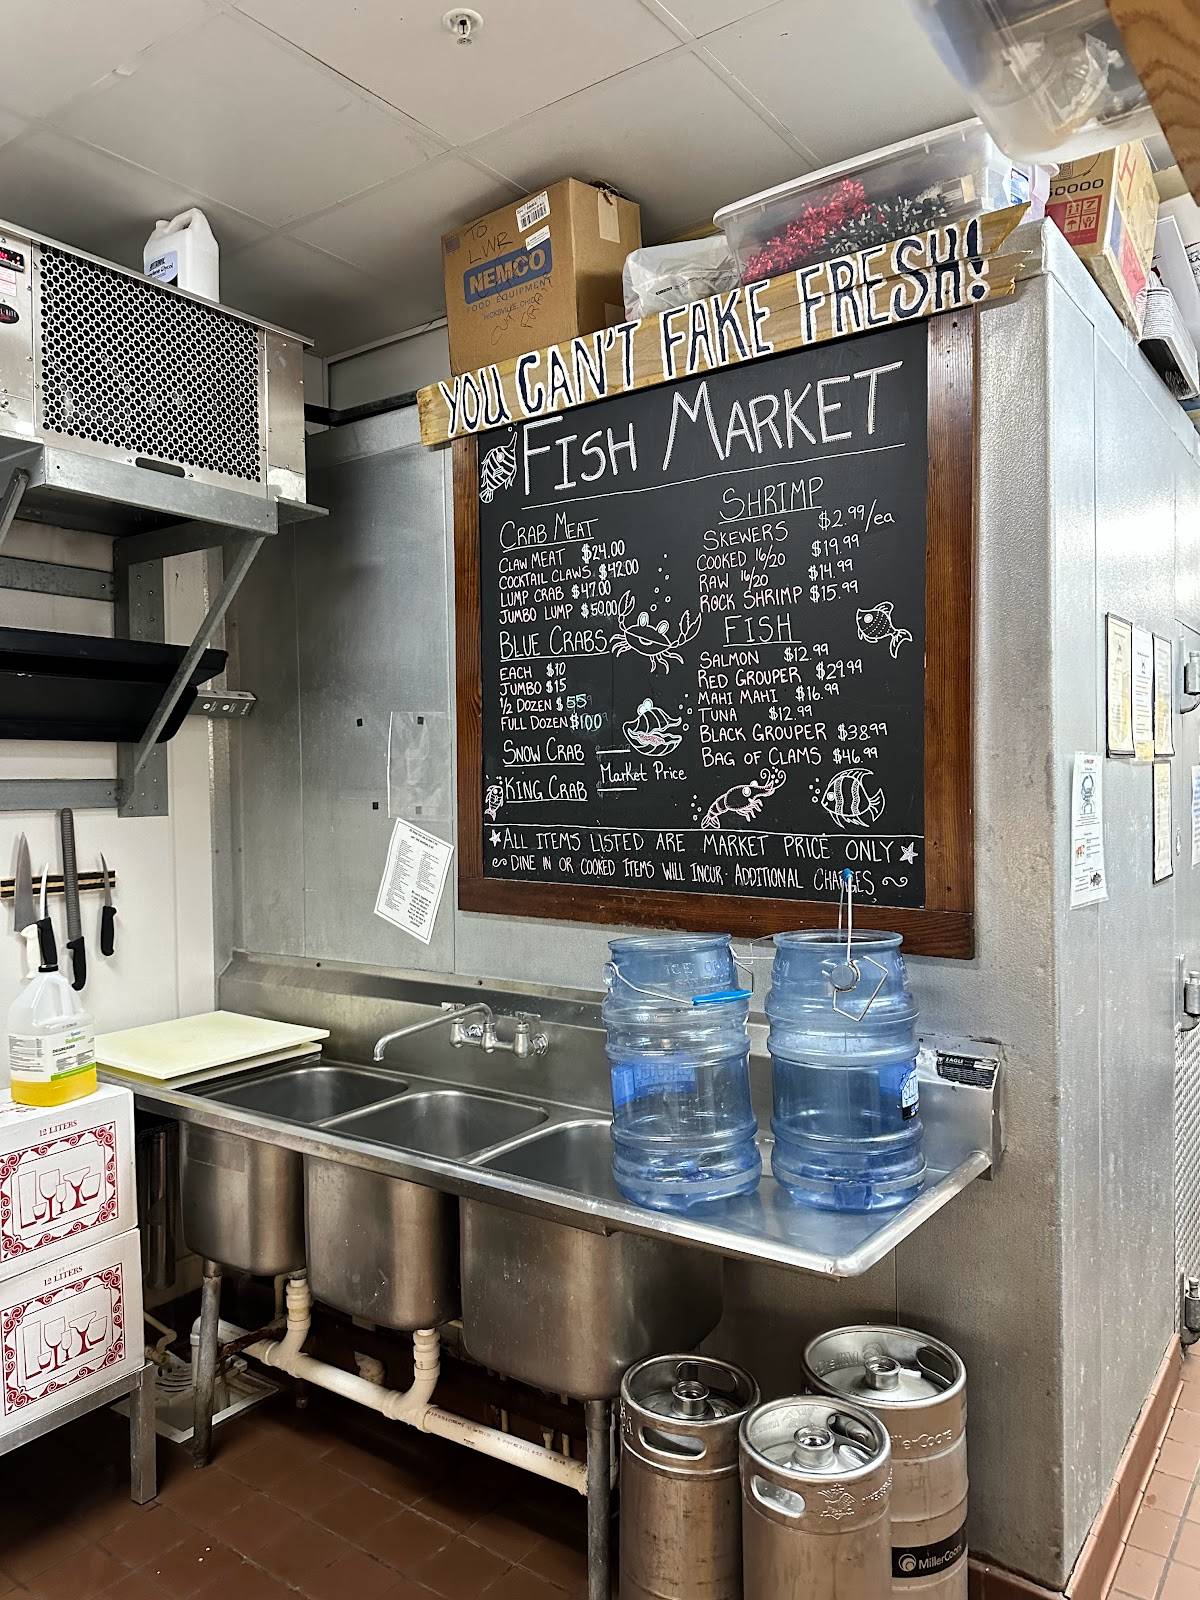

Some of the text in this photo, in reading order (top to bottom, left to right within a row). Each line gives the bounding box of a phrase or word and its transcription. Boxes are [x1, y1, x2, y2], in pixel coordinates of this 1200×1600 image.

[464, 221, 488, 240] TO
[469, 248, 546, 295] NEMCO
[440, 363, 513, 438] YOU
[518, 318, 641, 412] CAN'T
[661, 279, 772, 379] FAKE
[797, 218, 991, 343] FRESH!
[521, 361, 904, 496] FISH MARKET
[719, 476, 824, 521] SHRIMP
[500, 512, 599, 549] CRAB MEAT
[703, 498, 896, 551] SKEWERS $2.99/ea
[499, 539, 626, 574] CLAW MEAT $24.00
[696, 550, 747, 571] COOKED
[811, 533, 860, 558] $19.99
[499, 558, 640, 590] COCKTAIL CLAWS $42.00
[700, 573, 730, 593] RAW
[807, 558, 854, 582] $14.99
[500, 579, 612, 608] LUMP CRAB $47.00
[700, 579, 860, 614] ROCK SHRIMP $15.99
[499, 599, 618, 625] JUMBO LUMP $50.00
[500, 625, 608, 660] BLUE CRABS
[724, 613, 793, 643] FISH
[500, 660, 566, 681] EACH $10
[700, 643, 829, 670] SALMON $12.99
[499, 677, 568, 696] JUMBO $15
[697, 669, 728, 689] RED
[735, 666, 802, 687] GROUPER
[516, 697, 553, 713] DOZEN
[698, 682, 840, 705] MAHI MAHI $16.99
[500, 716, 528, 732] FULL
[530, 715, 569, 730] DOZEN
[697, 704, 813, 723] TUNA $12.99
[700, 722, 888, 744] BLACK GROUPER $38.99
[502, 736, 585, 765] SNOW CRAB
[701, 746, 879, 768] BAG OF CLAMS $46.99
[600, 761, 688, 784] Market Price
[505, 775, 589, 801] KING CRAB
[503, 828, 895, 863] ALL ITEMS LISTED ARE MARKET PRICE ONLY
[510, 855, 537, 872] DINE
[542, 857, 552, 871] IN
[558, 857, 574, 874] OR
[580, 857, 616, 877] COOKED
[622, 858, 655, 879] ITEMS
[662, 862, 686, 881] WILL
[735, 864, 804, 889] ADDITIONAL
[39, 1120, 78, 1137] 12 LITERS
[43, 1265, 83, 1286] 12 LITERS
